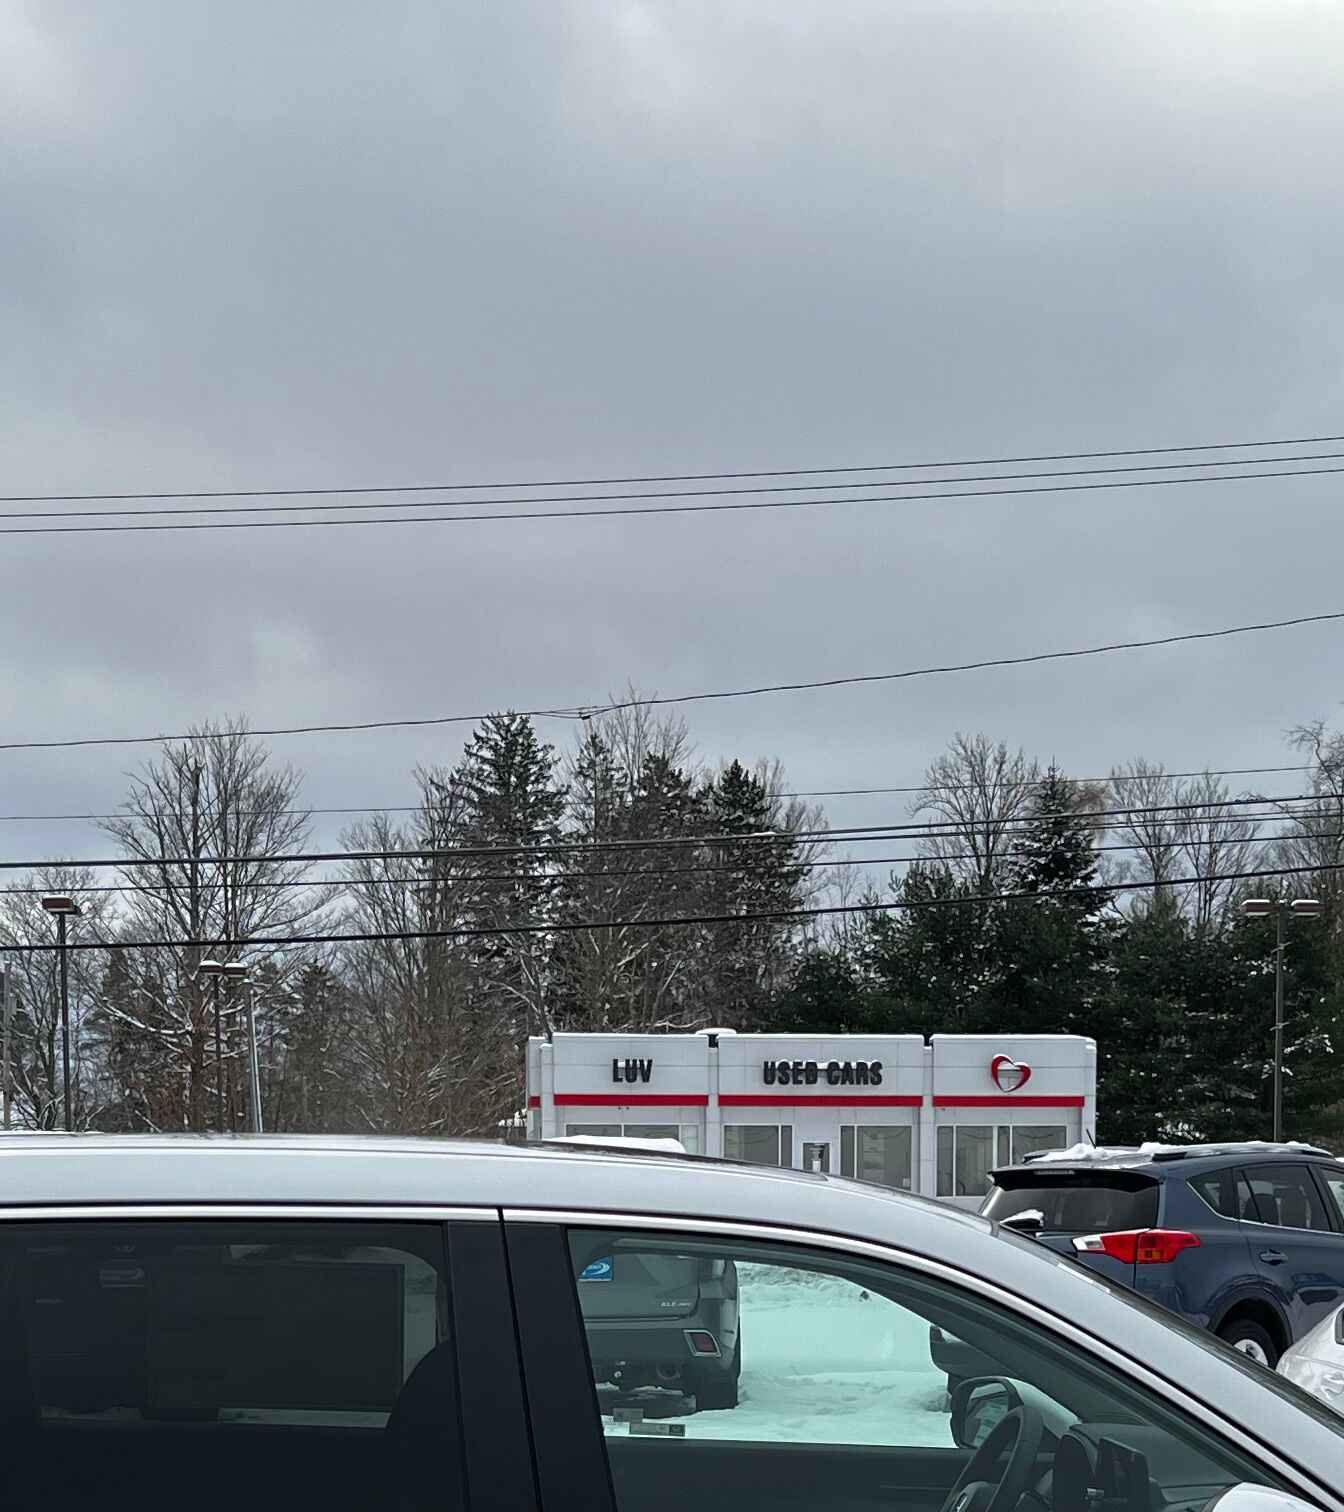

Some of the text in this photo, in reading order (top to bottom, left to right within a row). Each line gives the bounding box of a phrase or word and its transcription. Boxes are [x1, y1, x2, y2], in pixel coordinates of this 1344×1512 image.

[612, 1058, 653, 1083] LUV
[763, 1060, 883, 1086] USED CARS
